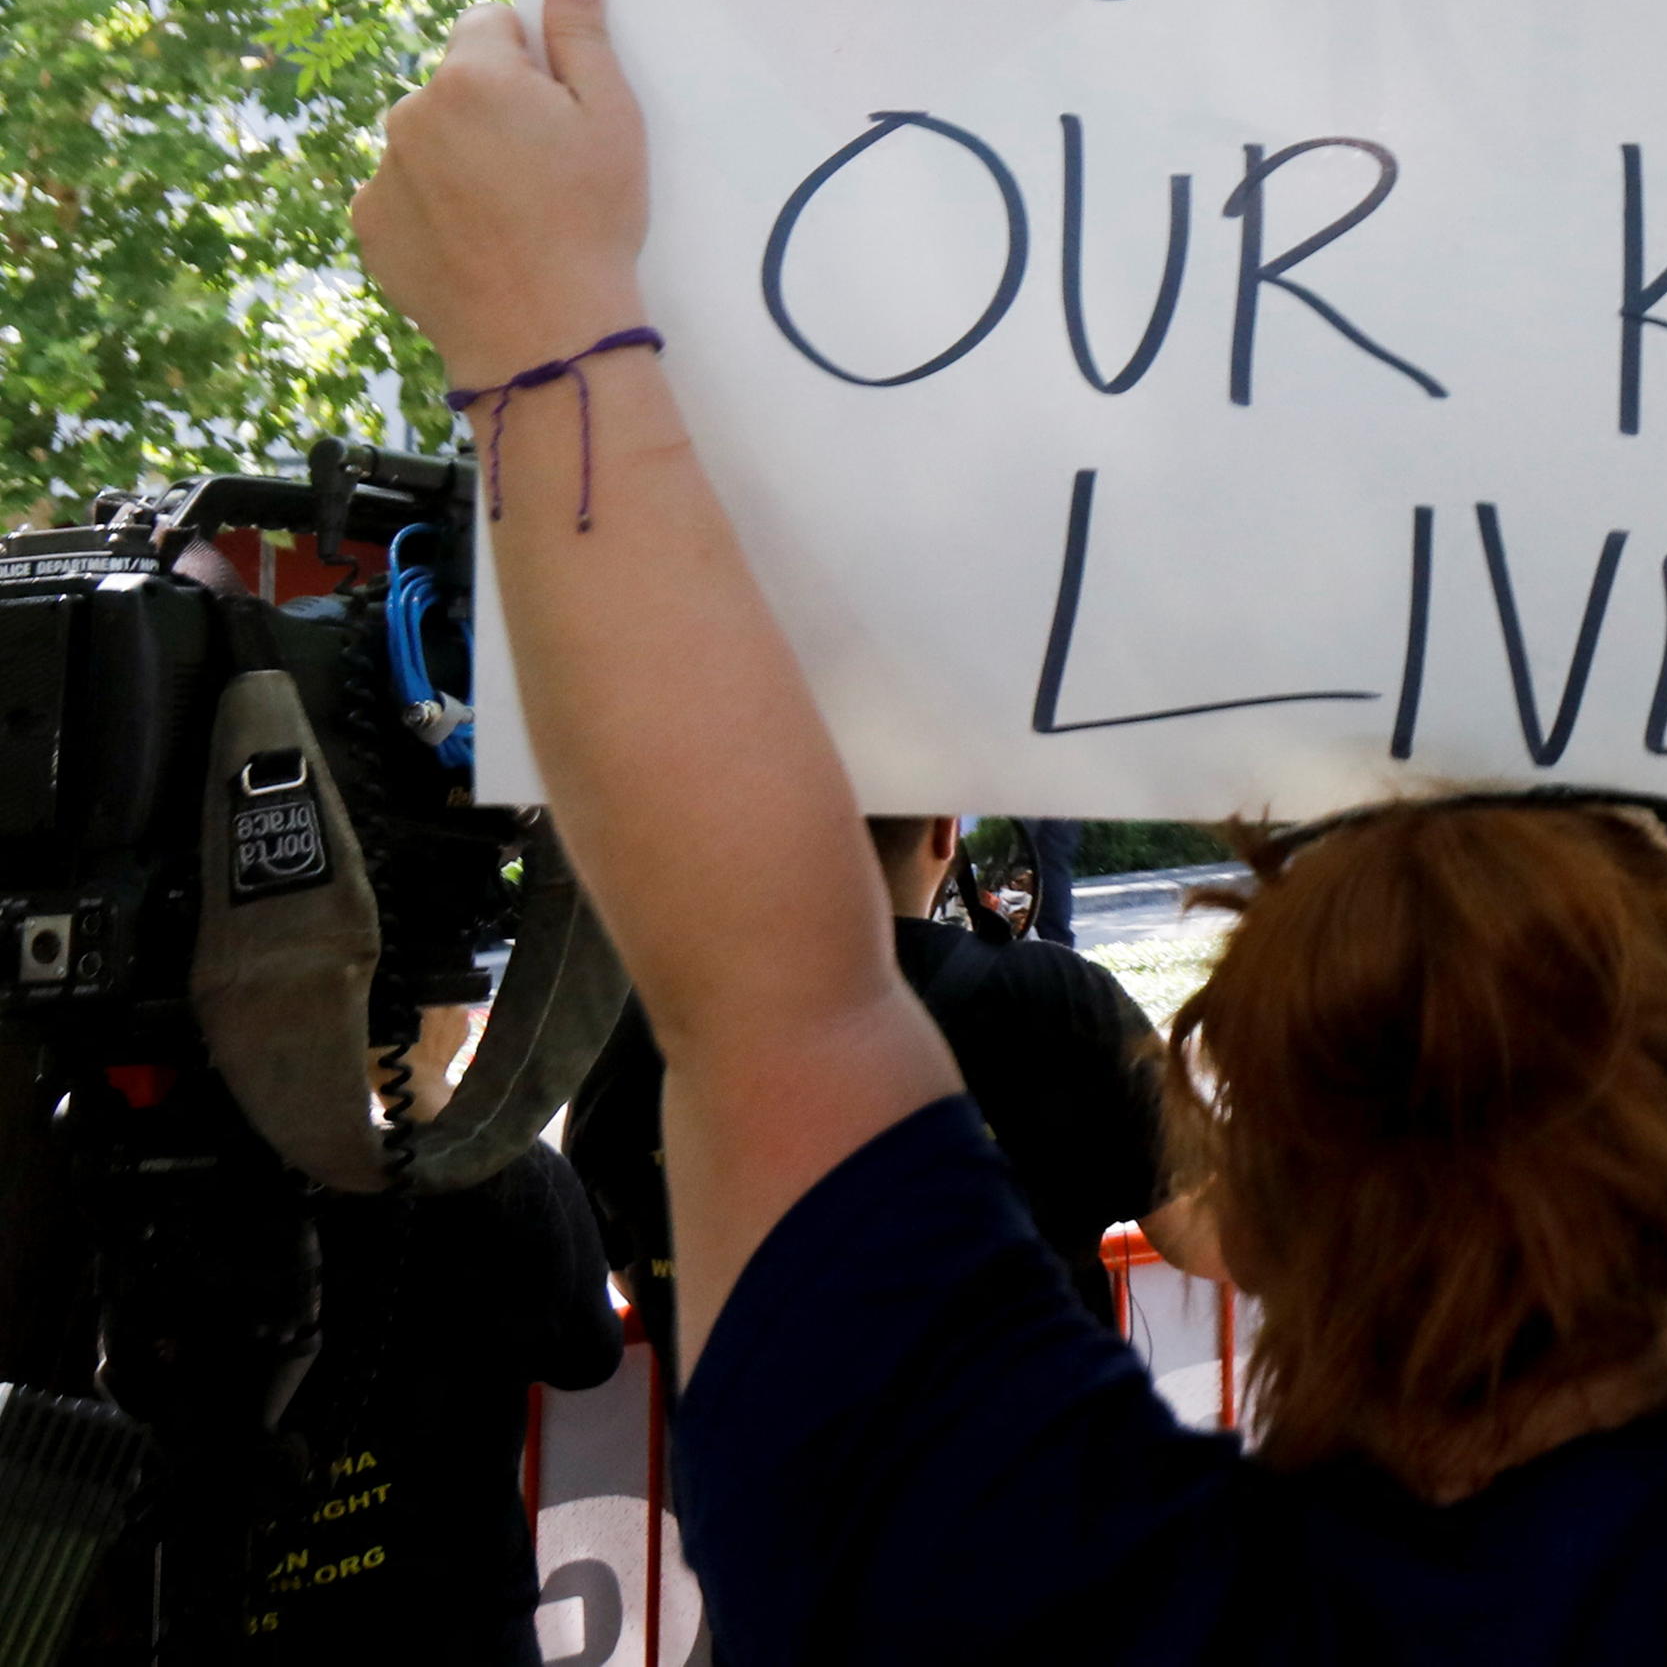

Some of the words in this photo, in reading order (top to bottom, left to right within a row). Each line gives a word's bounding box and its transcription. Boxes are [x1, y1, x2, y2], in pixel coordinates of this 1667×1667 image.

[761, 111, 1450, 407] OUR
[237, 806, 313, 840] brace
[240, 828, 317, 865] porta
